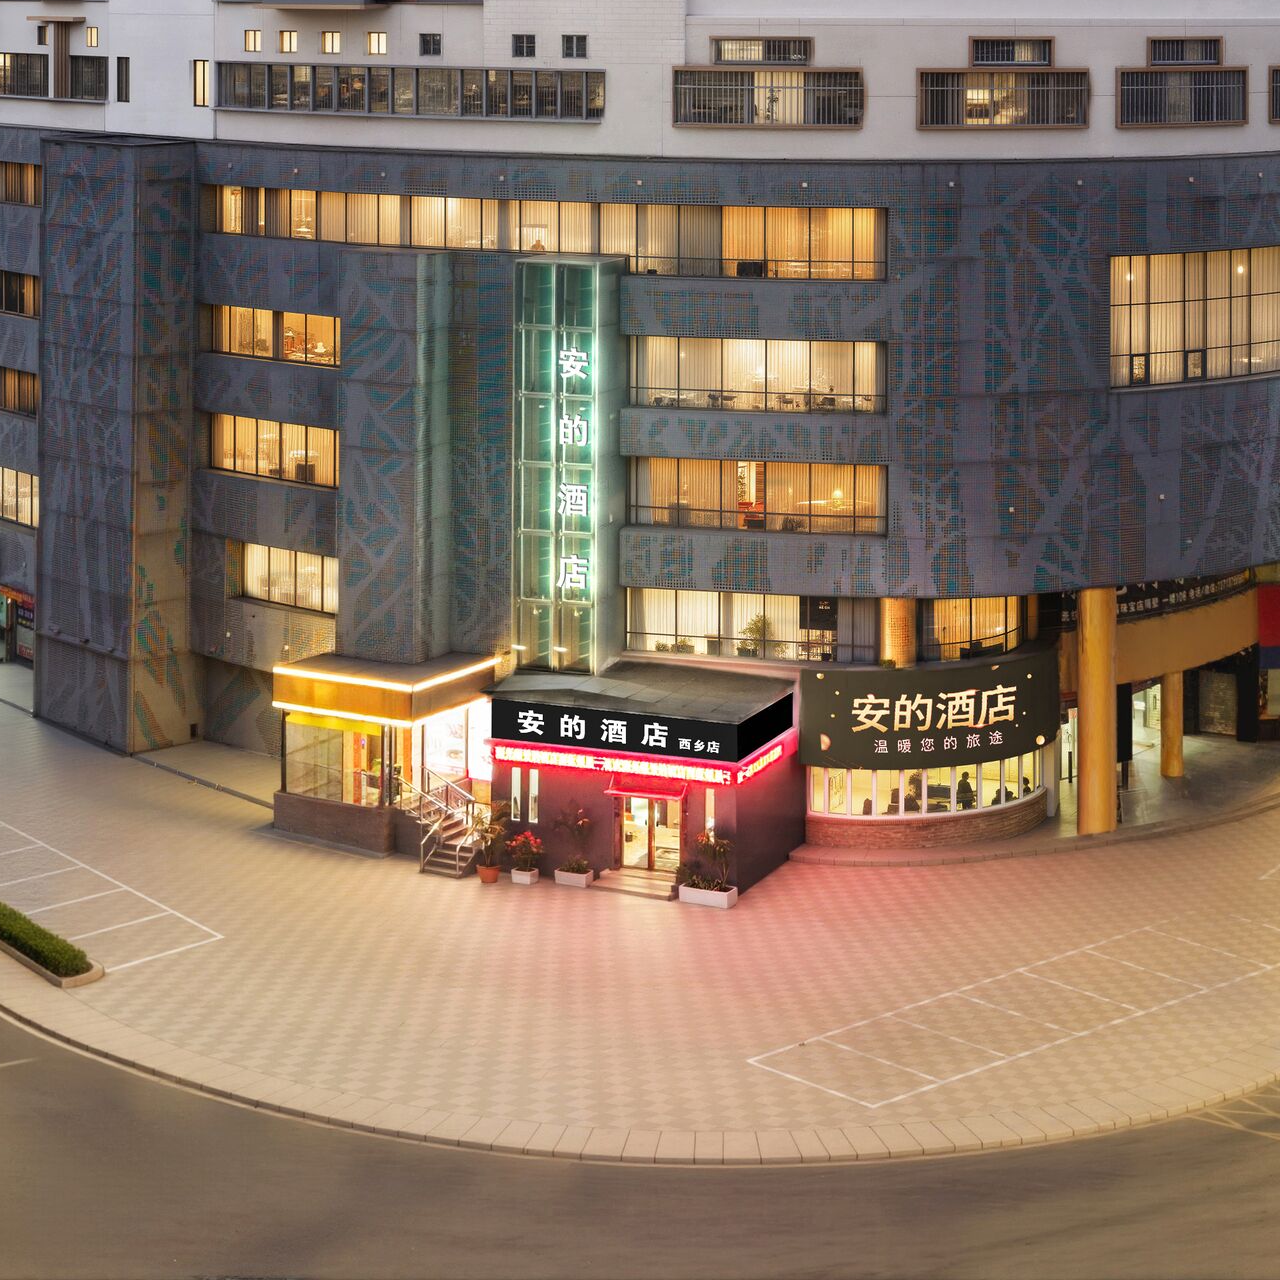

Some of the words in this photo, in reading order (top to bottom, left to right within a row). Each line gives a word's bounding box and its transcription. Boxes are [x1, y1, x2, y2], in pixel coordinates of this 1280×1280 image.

[557, 346, 589, 590] 安的酒店
[517, 709, 669, 749] 安的酒店
[677, 737, 721, 755] 西乡店
[851, 684, 1018, 734] 安的酒店
[873, 729, 1005, 755] 温暖您的旅途
